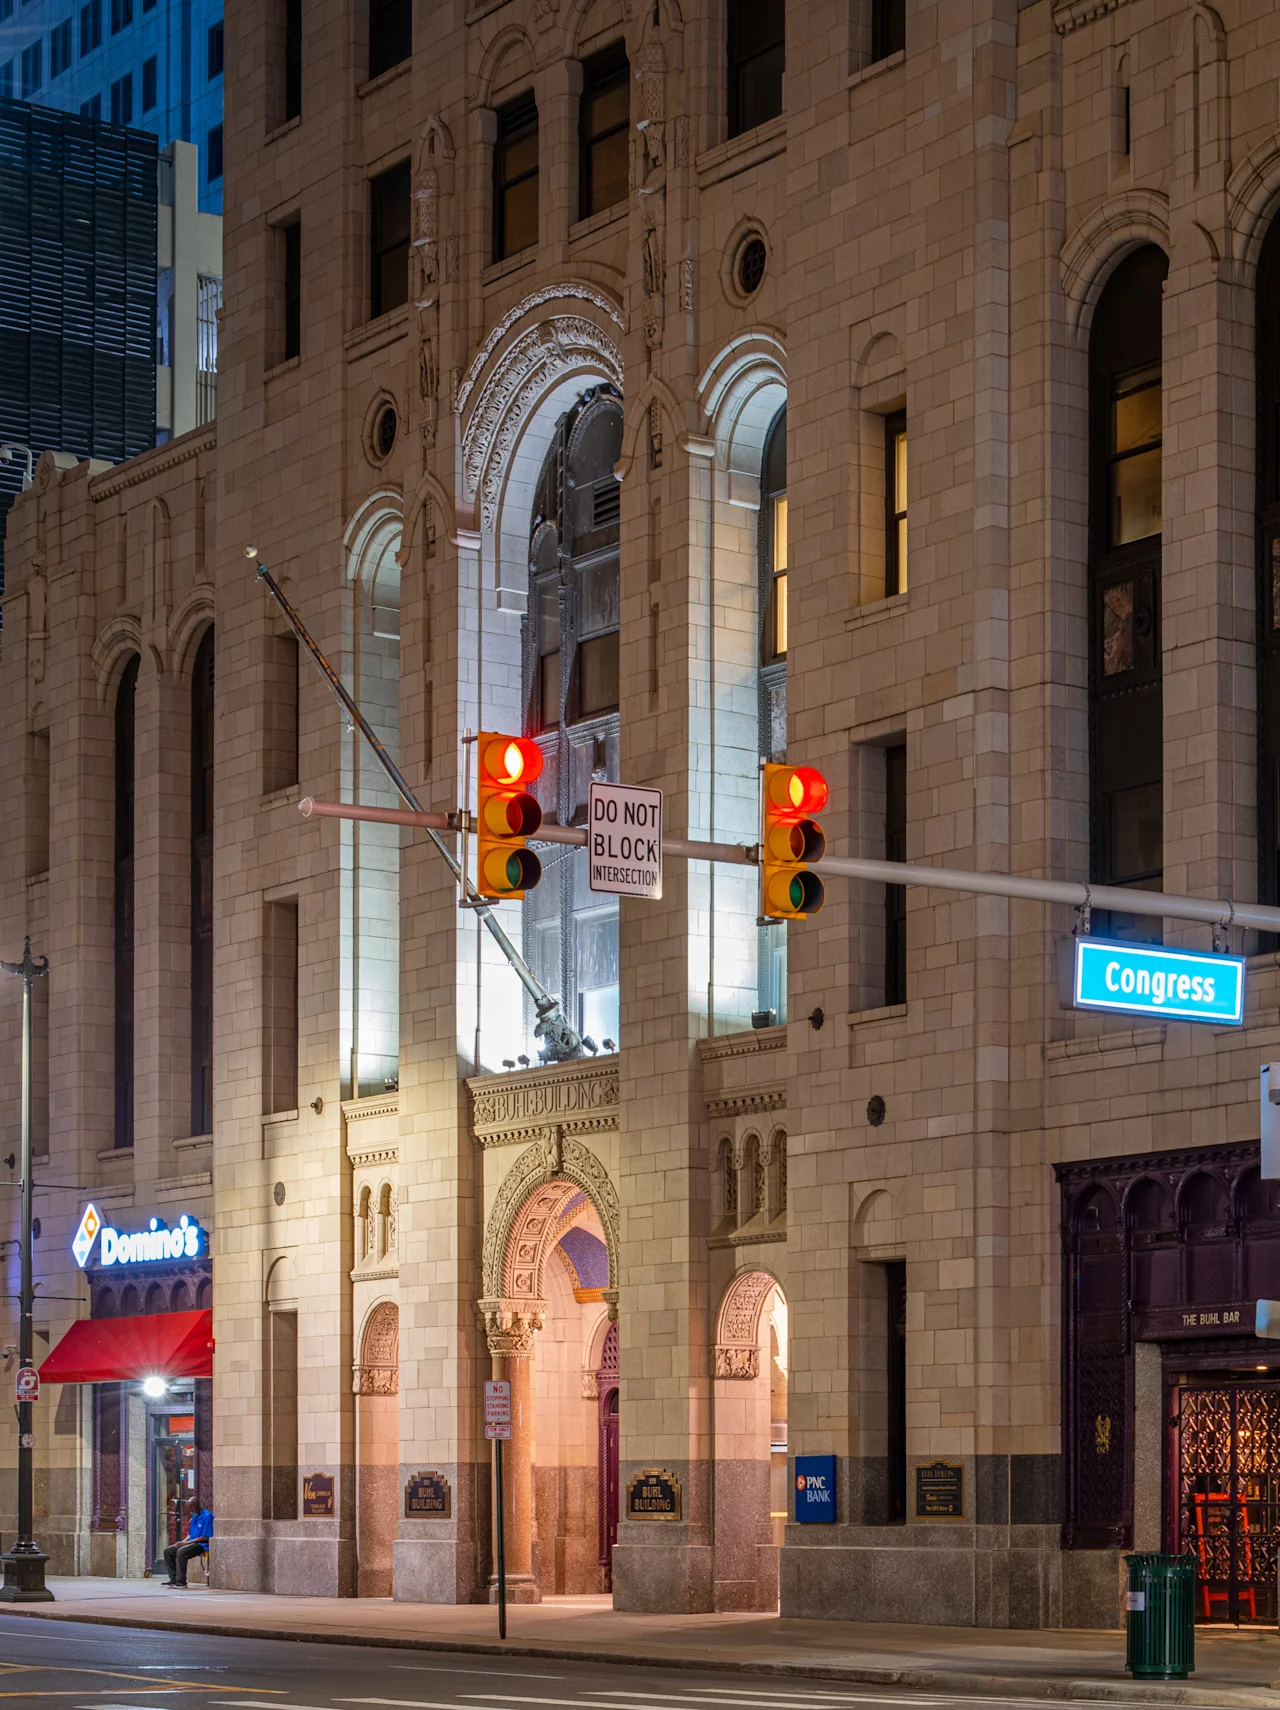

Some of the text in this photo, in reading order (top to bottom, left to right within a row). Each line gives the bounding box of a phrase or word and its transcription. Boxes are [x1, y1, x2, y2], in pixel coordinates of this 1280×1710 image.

[594, 798, 658, 827] DO NOT
[594, 833, 657, 862] BLOCK
[593, 865, 657, 887] INTERSECTION
[1105, 961, 1215, 1004] Congress
[494, 1081, 602, 1121] BUHL BUILDING
[101, 1215, 199, 1266] Domino's
[1182, 1312, 1240, 1326] THE BUHL BAR
[493, 1385, 504, 1393] NO
[806, 1476, 826, 1489] PNC
[418, 1487, 435, 1498] BUHL
[642, 1486, 663, 1498] BUHL
[806, 1490, 831, 1503] BANK
[411, 1499, 442, 1510] BUILDING
[634, 1499, 671, 1510] BUILDING
